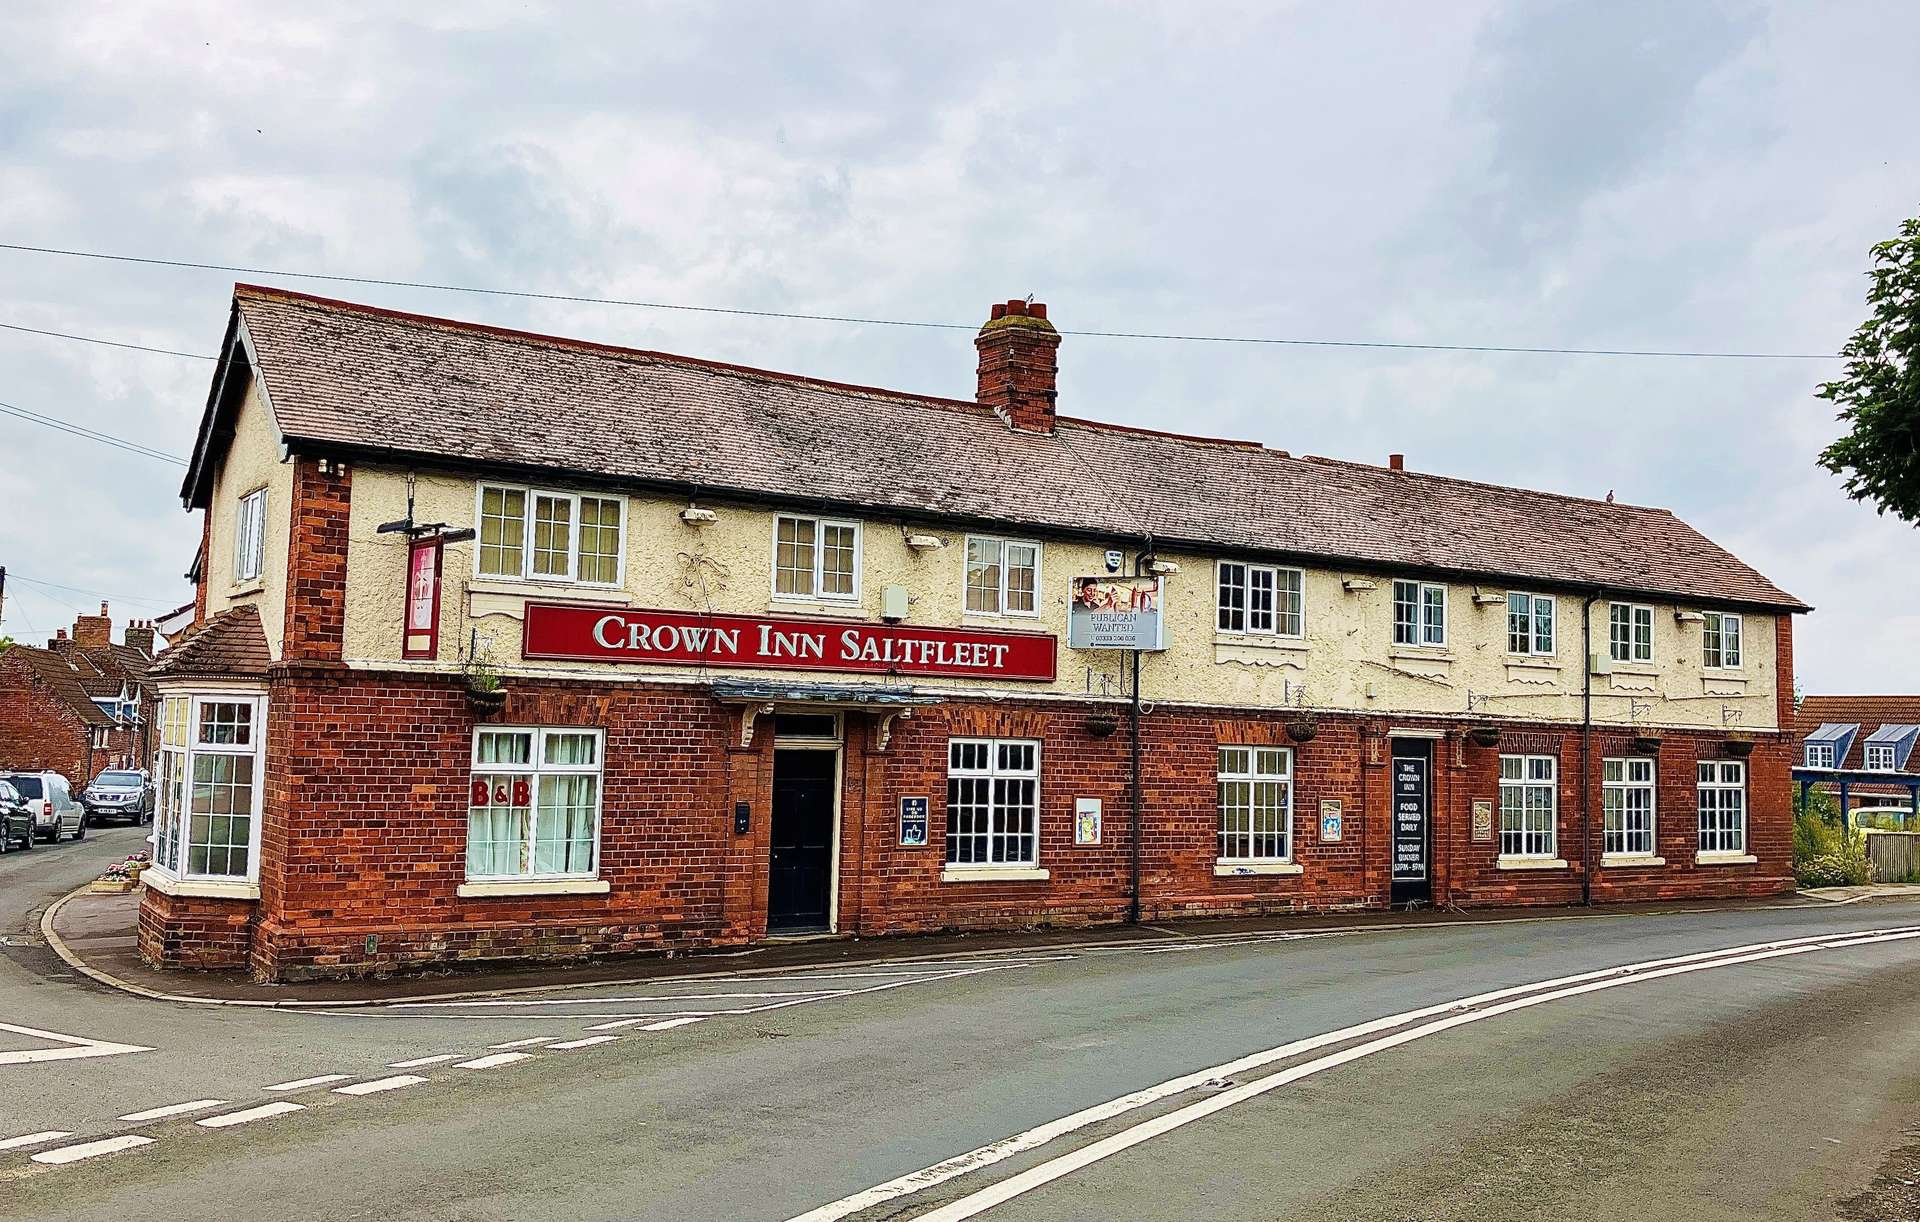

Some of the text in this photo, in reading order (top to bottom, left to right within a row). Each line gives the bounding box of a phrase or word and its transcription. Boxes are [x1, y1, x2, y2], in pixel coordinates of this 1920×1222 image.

[1091, 613, 1137, 622] PUBLICAN
[1093, 623, 1134, 632] WANTED
[593, 615, 1009, 668] CROWN INN SALTFLEET
[1403, 764, 1415, 772] THE
[1398, 773, 1420, 782] CROWN
[1403, 783, 1415, 791] INN
[472, 781, 529, 806] B & B
[1400, 802, 1418, 811] FOOD
[1397, 812, 1421, 821] SERVED
[1400, 822, 1418, 831] DAILY
[1397, 843, 1420, 852] SUNDAY
